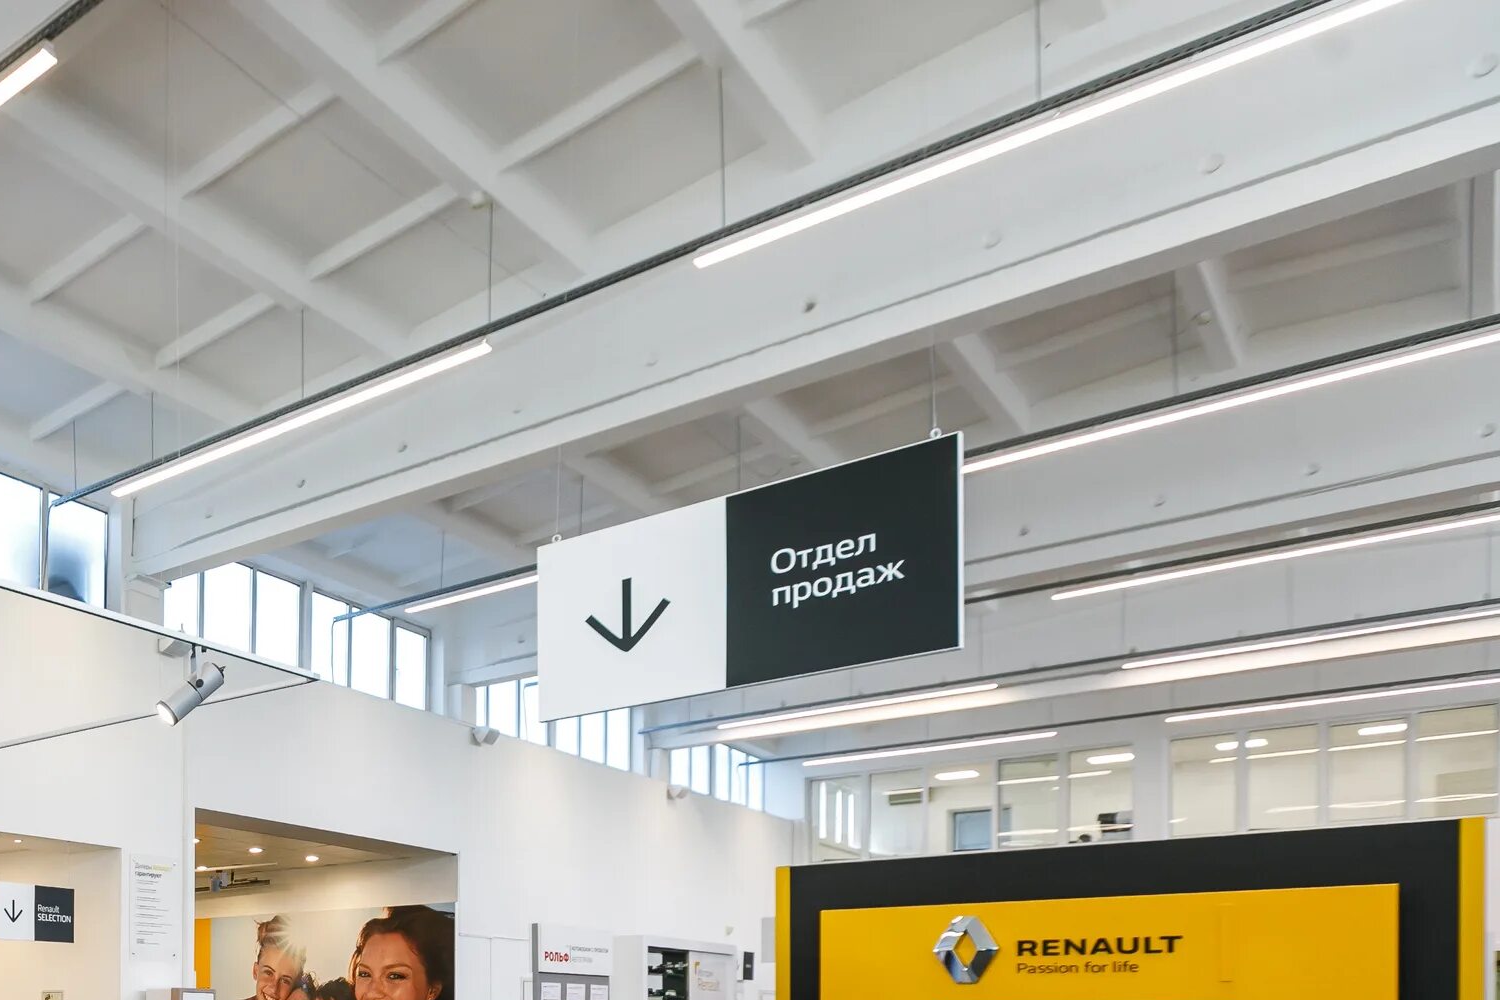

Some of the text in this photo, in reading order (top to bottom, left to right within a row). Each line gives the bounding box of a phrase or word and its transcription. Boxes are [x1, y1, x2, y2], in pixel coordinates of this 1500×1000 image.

[770, 532, 877, 575] Отдел
[771, 559, 906, 608] продаж
[37, 903, 60, 914] Renault
[37, 912, 72, 923] SELECTION
[1016, 935, 1184, 957] RENAULT
[544, 951, 570, 963] РОЛЬФ
[1016, 960, 1140, 974] Passion for life
